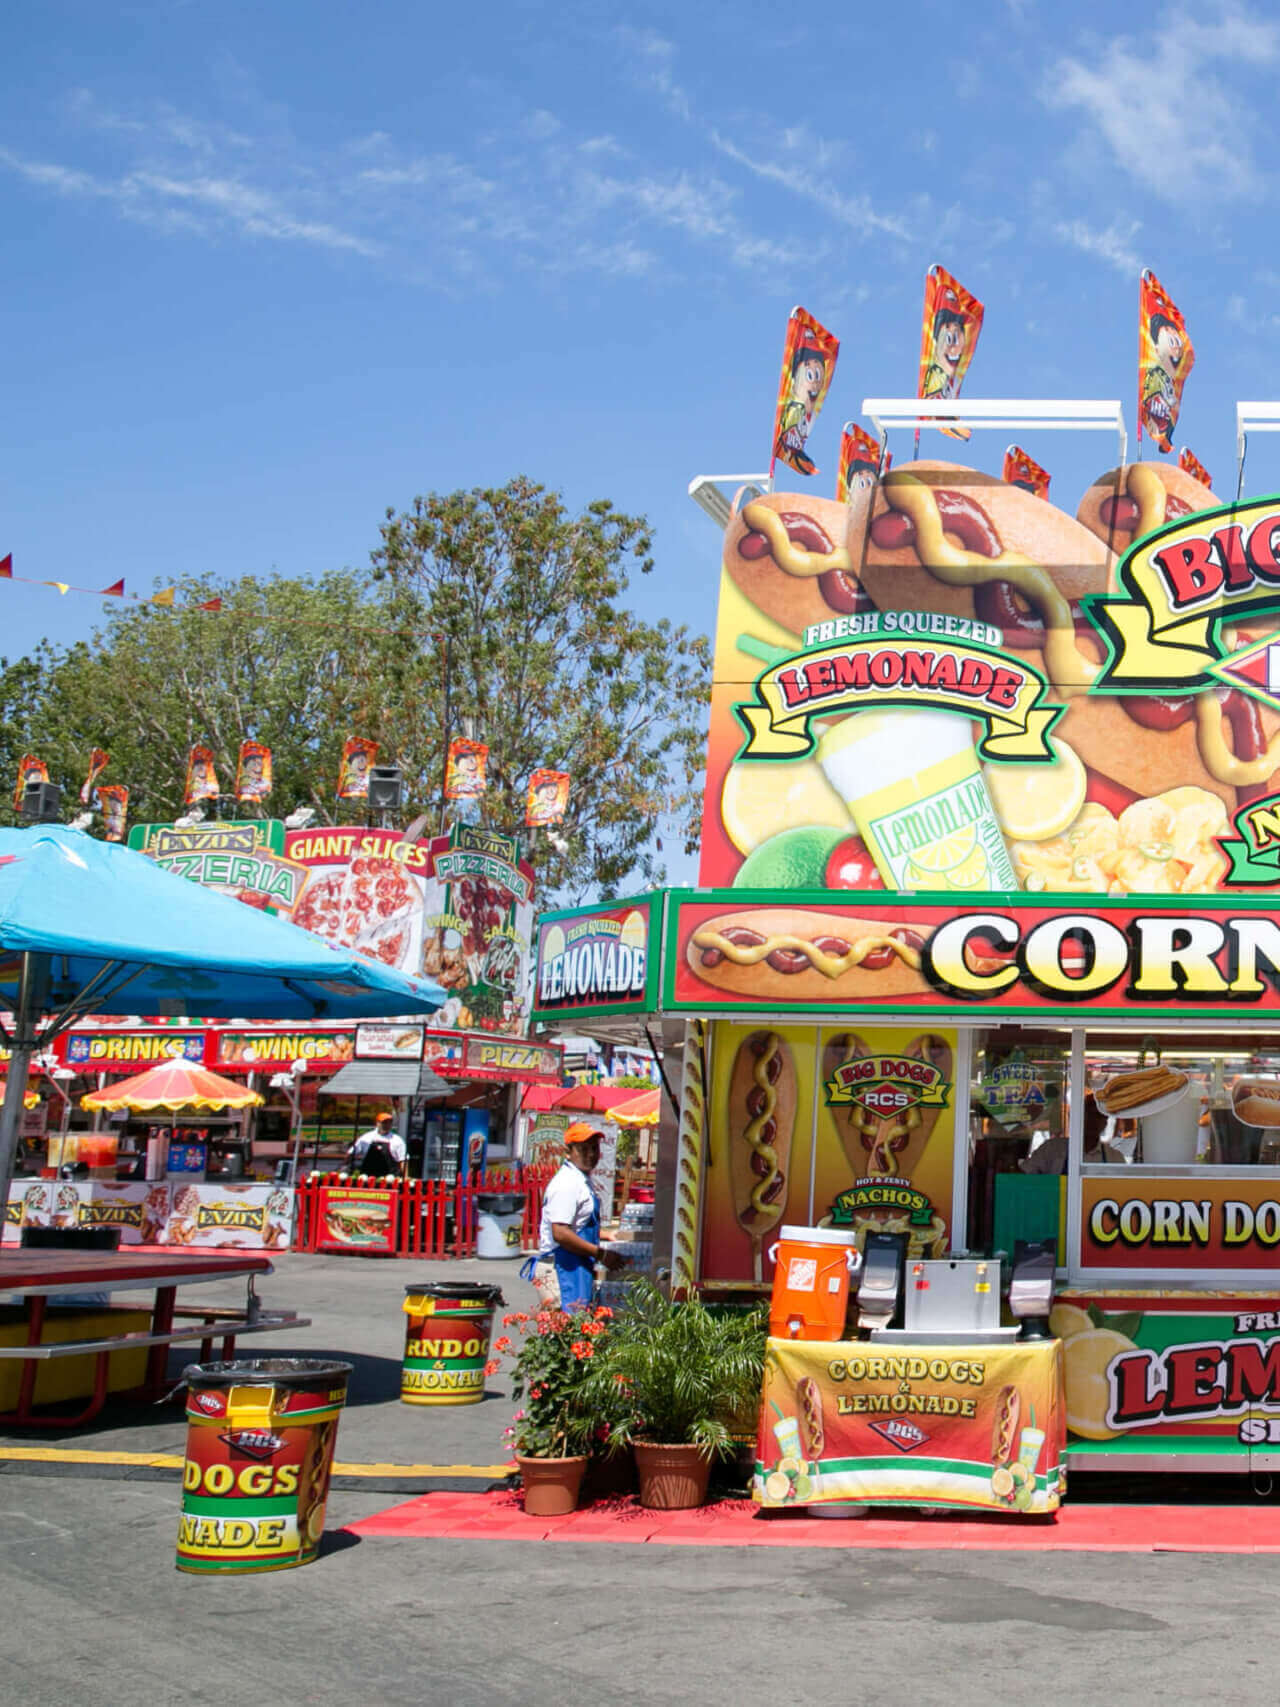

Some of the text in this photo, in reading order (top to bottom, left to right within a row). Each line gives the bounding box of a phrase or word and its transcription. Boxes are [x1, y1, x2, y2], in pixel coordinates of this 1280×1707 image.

[806, 613, 1001, 647] FRESH SQUEEZED
[779, 651, 1024, 707] LEMONADE
[289, 836, 428, 867] GIANT SLICES
[438, 854, 525, 900] PIZZERIA
[426, 914, 469, 937] WINGS
[541, 941, 645, 1001] LEMONADE
[89, 1037, 187, 1060] DRINKS
[250, 1037, 331, 1060] WINGS
[480, 1045, 543, 1069] PIZZA
[840, 1060, 936, 1085] BIG DOGS
[992, 1062, 1039, 1084] SWEET
[865, 1093, 908, 1106] RCS
[984, 1085, 1046, 1106] TEA
[856, 1177, 875, 1187] HOT
[884, 1177, 911, 1187] ZESTY
[841, 1189, 925, 1210] NACHOS
[1090, 1199, 1212, 1243] CORN
[432, 1360, 446, 1371] &
[827, 1358, 985, 1384] CORNDOGS
[899, 1382, 910, 1394] &
[837, 1394, 977, 1417] LEMONADE
[887, 1421, 923, 1441] RCS
[184, 1460, 300, 1495] DOGS
[179, 1516, 284, 1547] NADE
